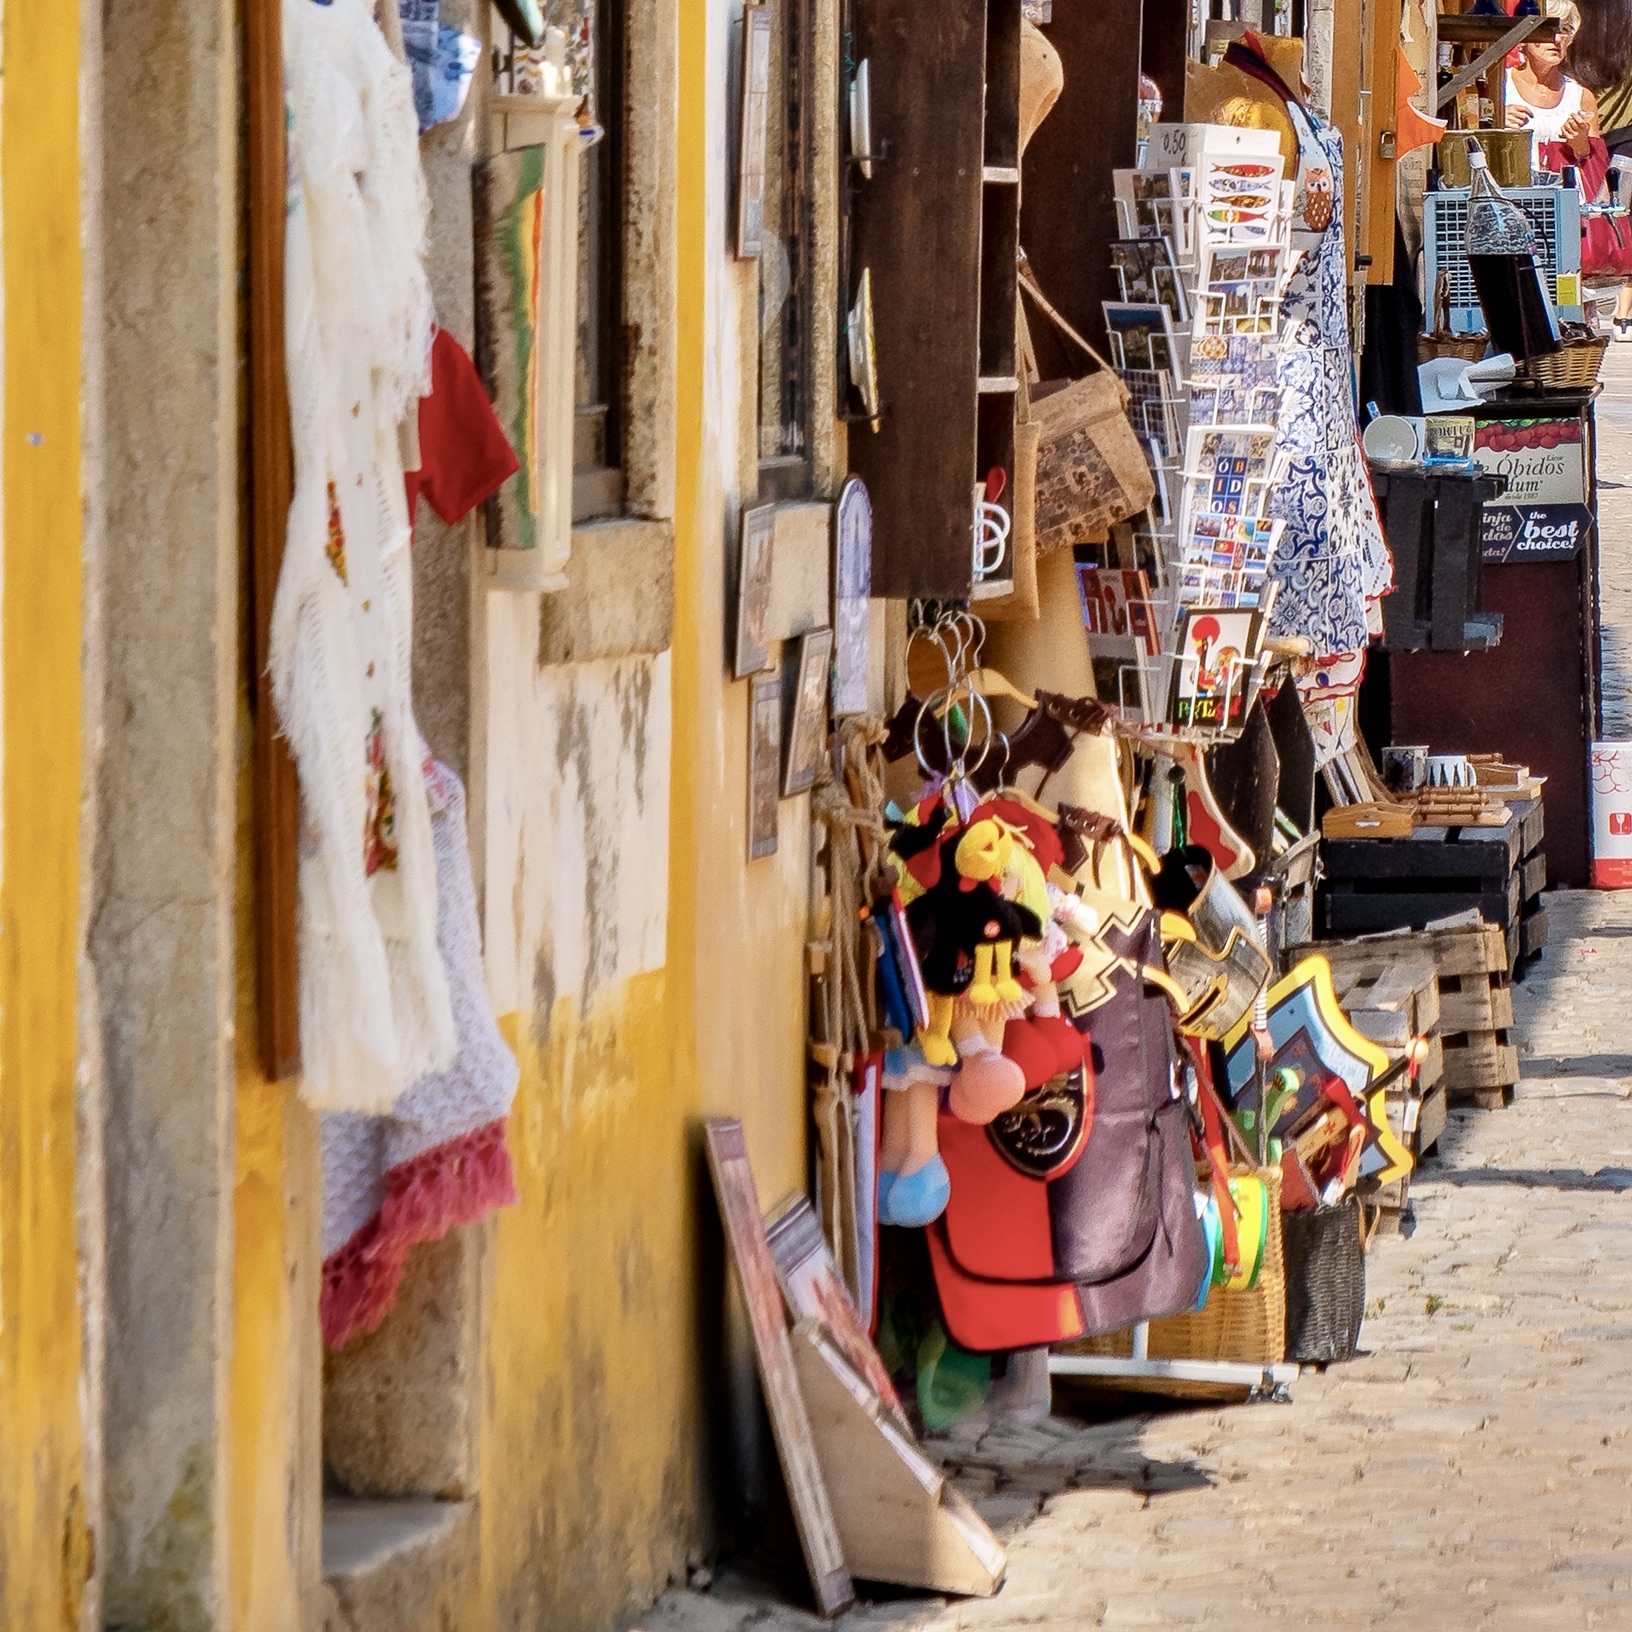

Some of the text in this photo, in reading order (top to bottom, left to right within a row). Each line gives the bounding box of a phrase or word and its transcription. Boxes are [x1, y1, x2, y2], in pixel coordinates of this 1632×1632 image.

[1497, 453, 1565, 476] Óbidos
[1530, 511, 1547, 519] the
[1524, 520, 1579, 539] best
[1517, 537, 1576, 550] choice!
